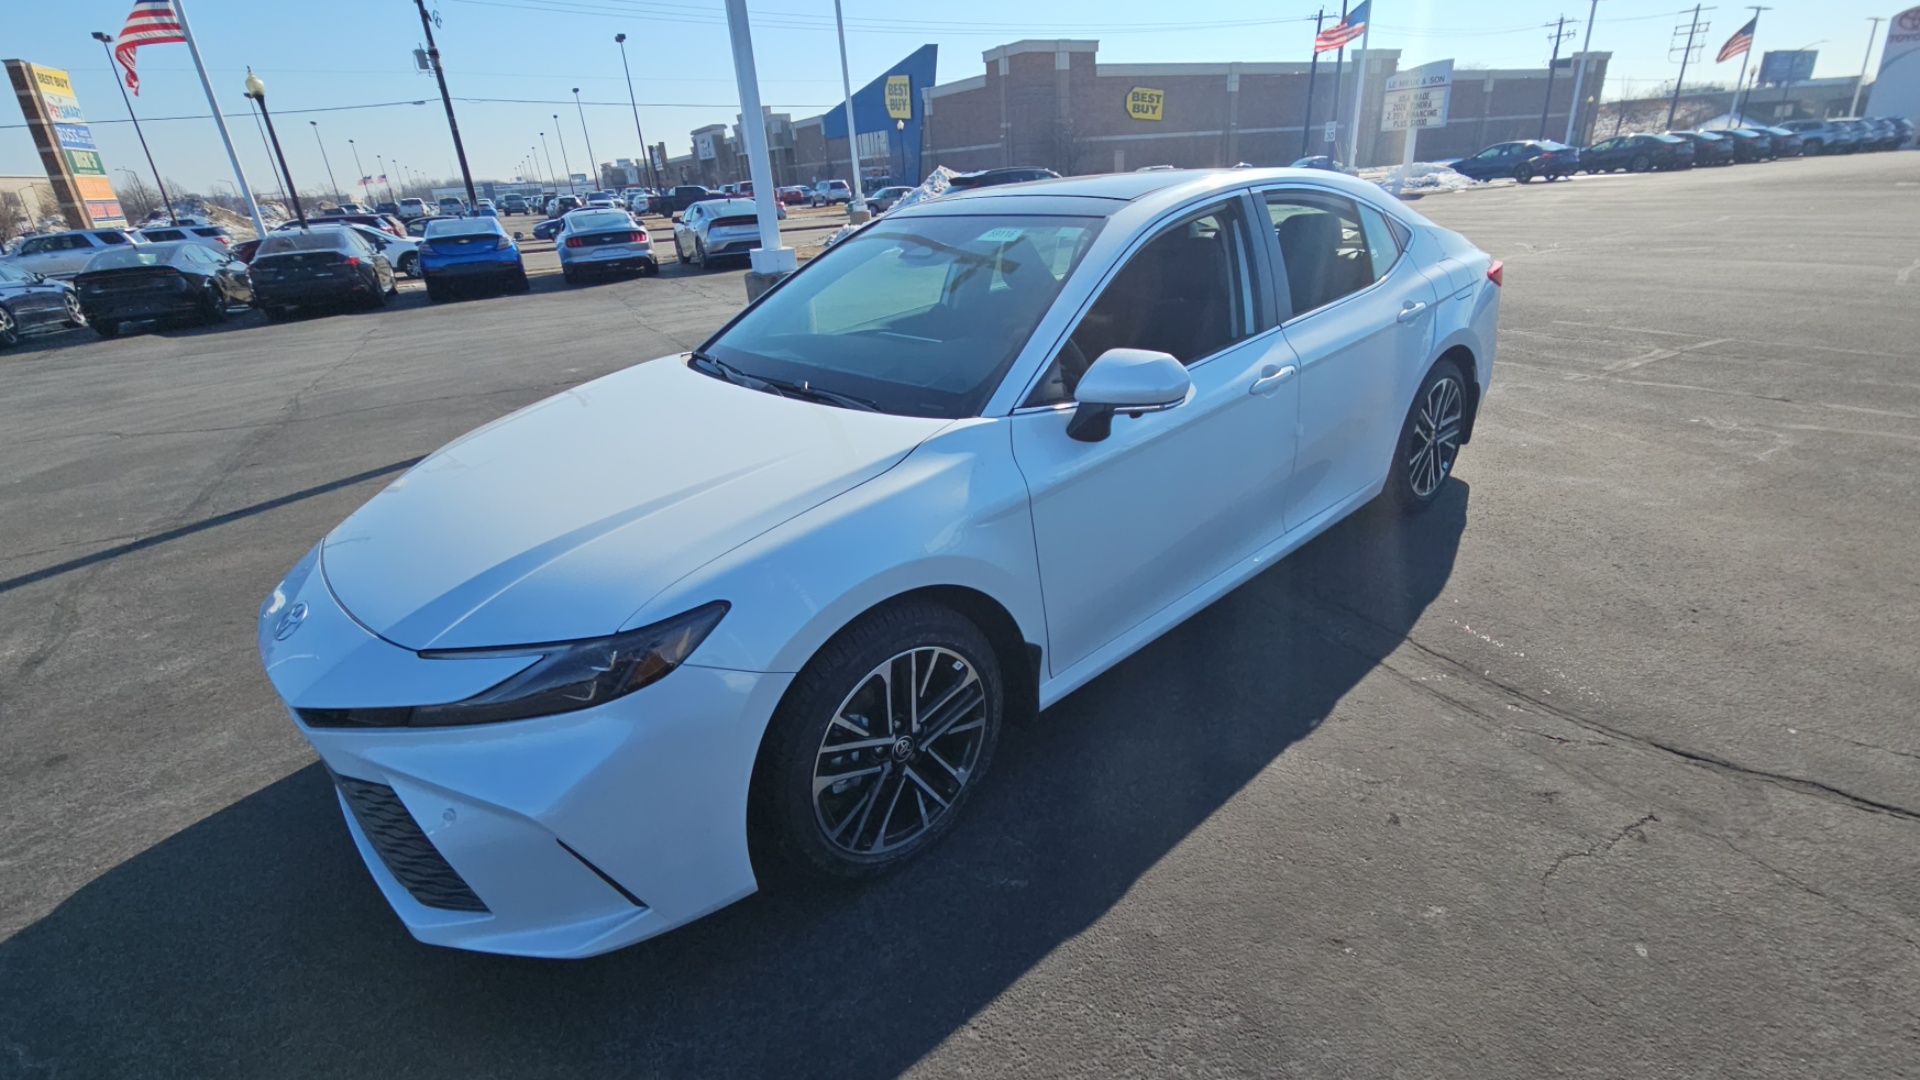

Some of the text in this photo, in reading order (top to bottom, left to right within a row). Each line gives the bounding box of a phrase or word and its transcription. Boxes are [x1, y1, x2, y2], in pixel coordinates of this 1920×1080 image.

[36, 72, 70, 89] BEST BUY
[1388, 81, 1396, 89] LE
[1421, 77, 1427, 85] &
[1430, 75, 1446, 84] SON
[888, 83, 908, 96] BEST
[1132, 92, 1162, 104] BEST
[1413, 92, 1430, 100] MADE
[890, 98, 907, 111] BUY
[1132, 103, 1158, 115] BUY
[1411, 100, 1433, 110] TUNDRA
[1406, 109, 1438, 118] FINANCING
[1393, 120, 1407, 128] PLUS
[1326, 131, 1335, 141] 30
